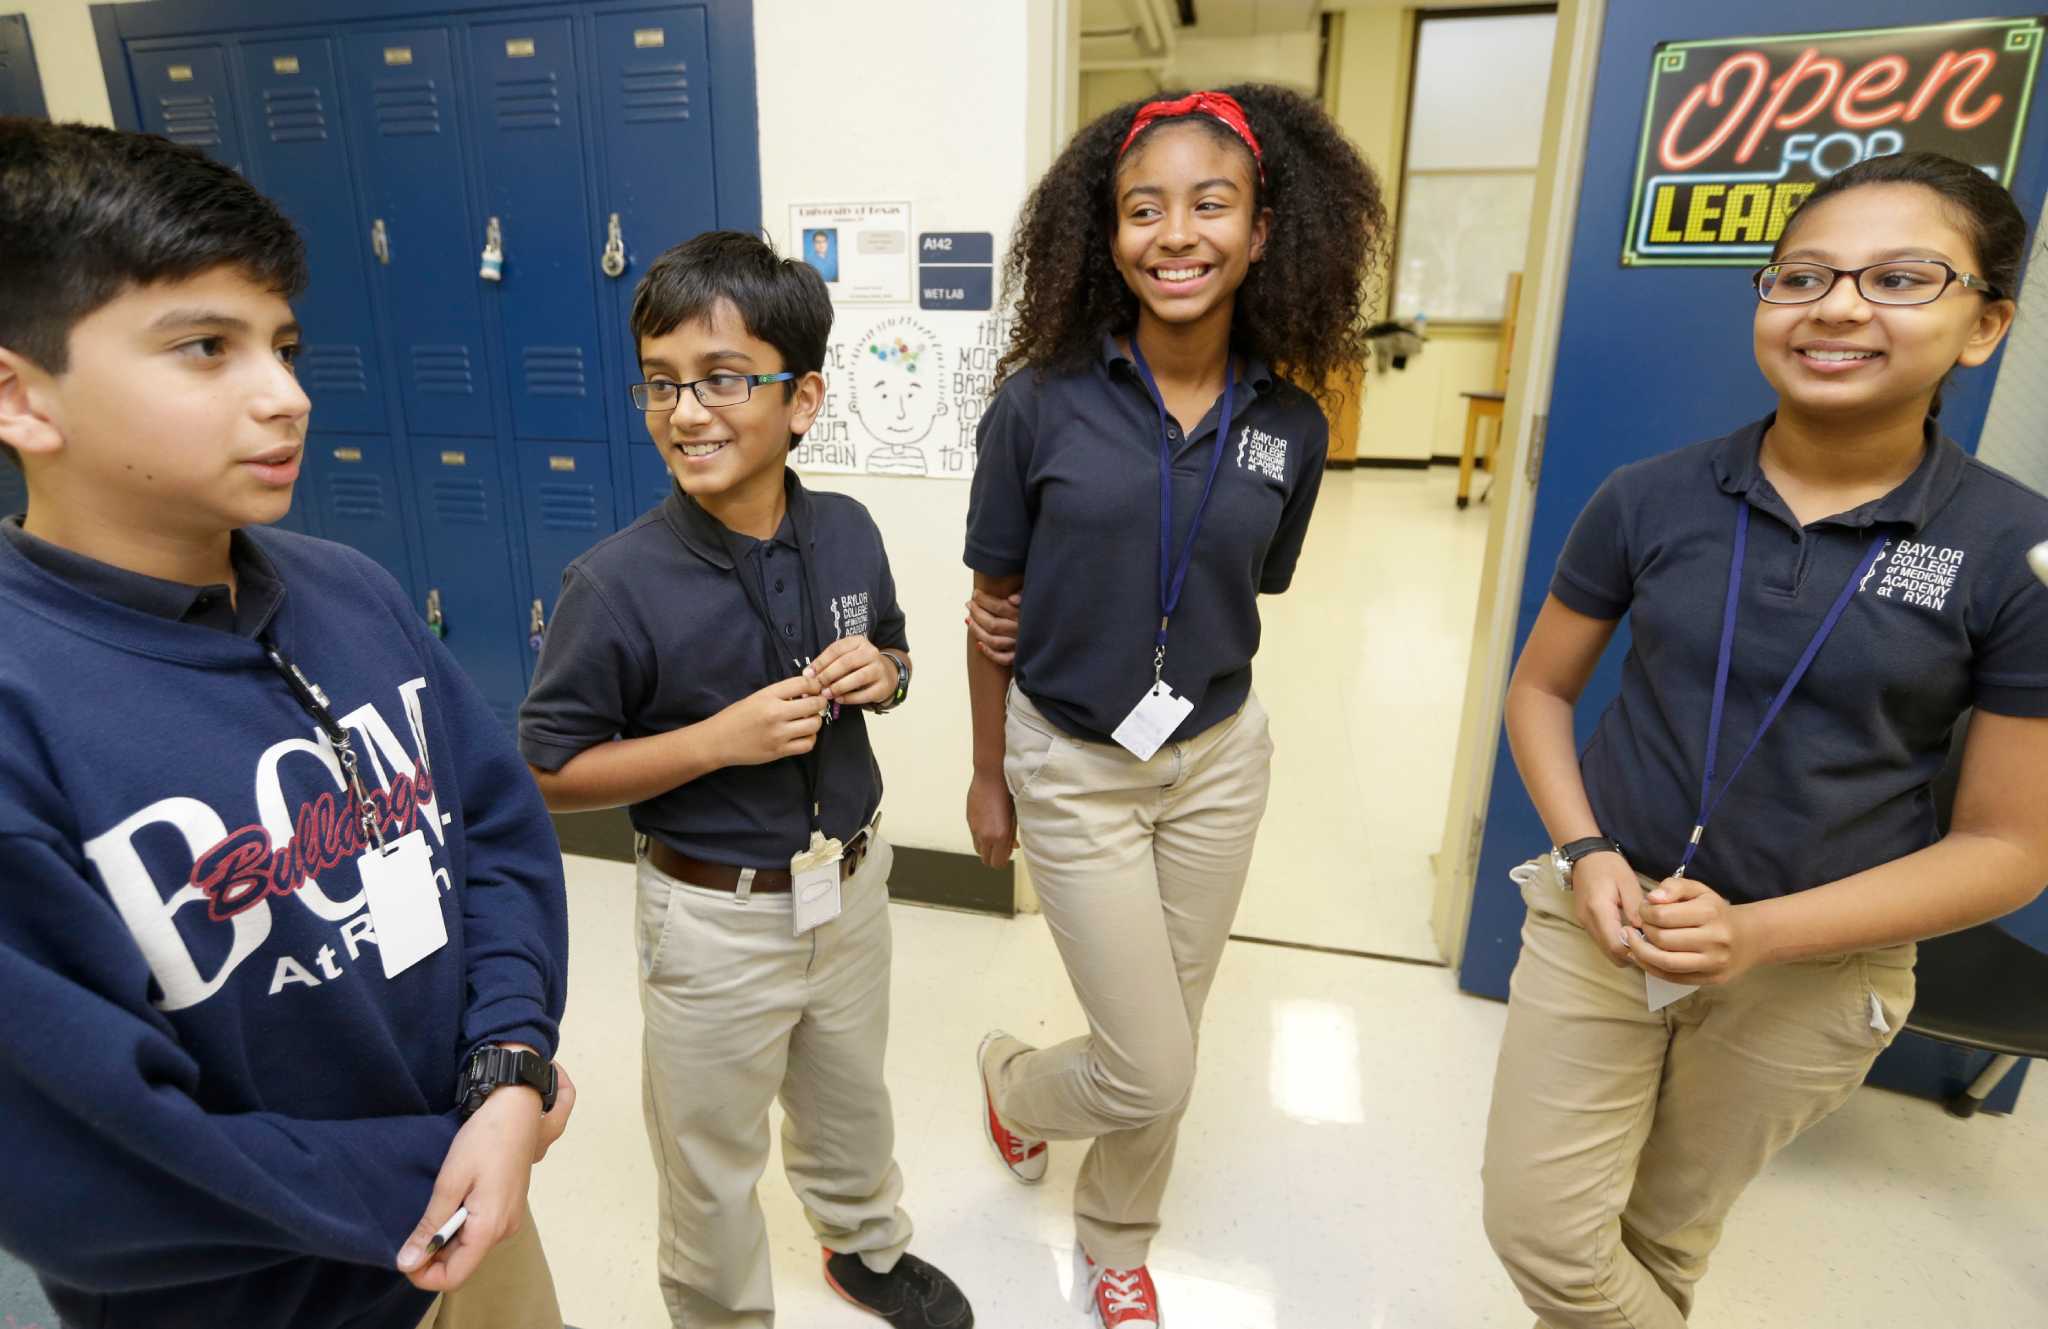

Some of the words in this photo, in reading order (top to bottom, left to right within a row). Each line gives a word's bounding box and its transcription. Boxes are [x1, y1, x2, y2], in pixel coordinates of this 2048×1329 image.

[1659, 47, 2003, 171] Open
[1649, 182, 1816, 243] LEAR
[923, 237, 953, 250] A142
[923, 288, 944, 299] WET
[945, 288, 965, 300] LAB
[958, 347, 1004, 370] MOR
[1250, 440, 1286, 458] COLLEGE
[1252, 429, 1287, 451] BAYLOR
[1896, 540, 1964, 565] BAYLOR
[1886, 566, 1900, 574] of
[1900, 567, 1956, 587] MEDICINE
[1890, 553, 1960, 577] COLLEGE
[1881, 574, 1951, 598] ACADEMY
[1876, 586, 1894, 597] at
[1903, 591, 1945, 611] RYAN
[268, 943, 343, 995] At
[339, 866, 452, 961] Rn
